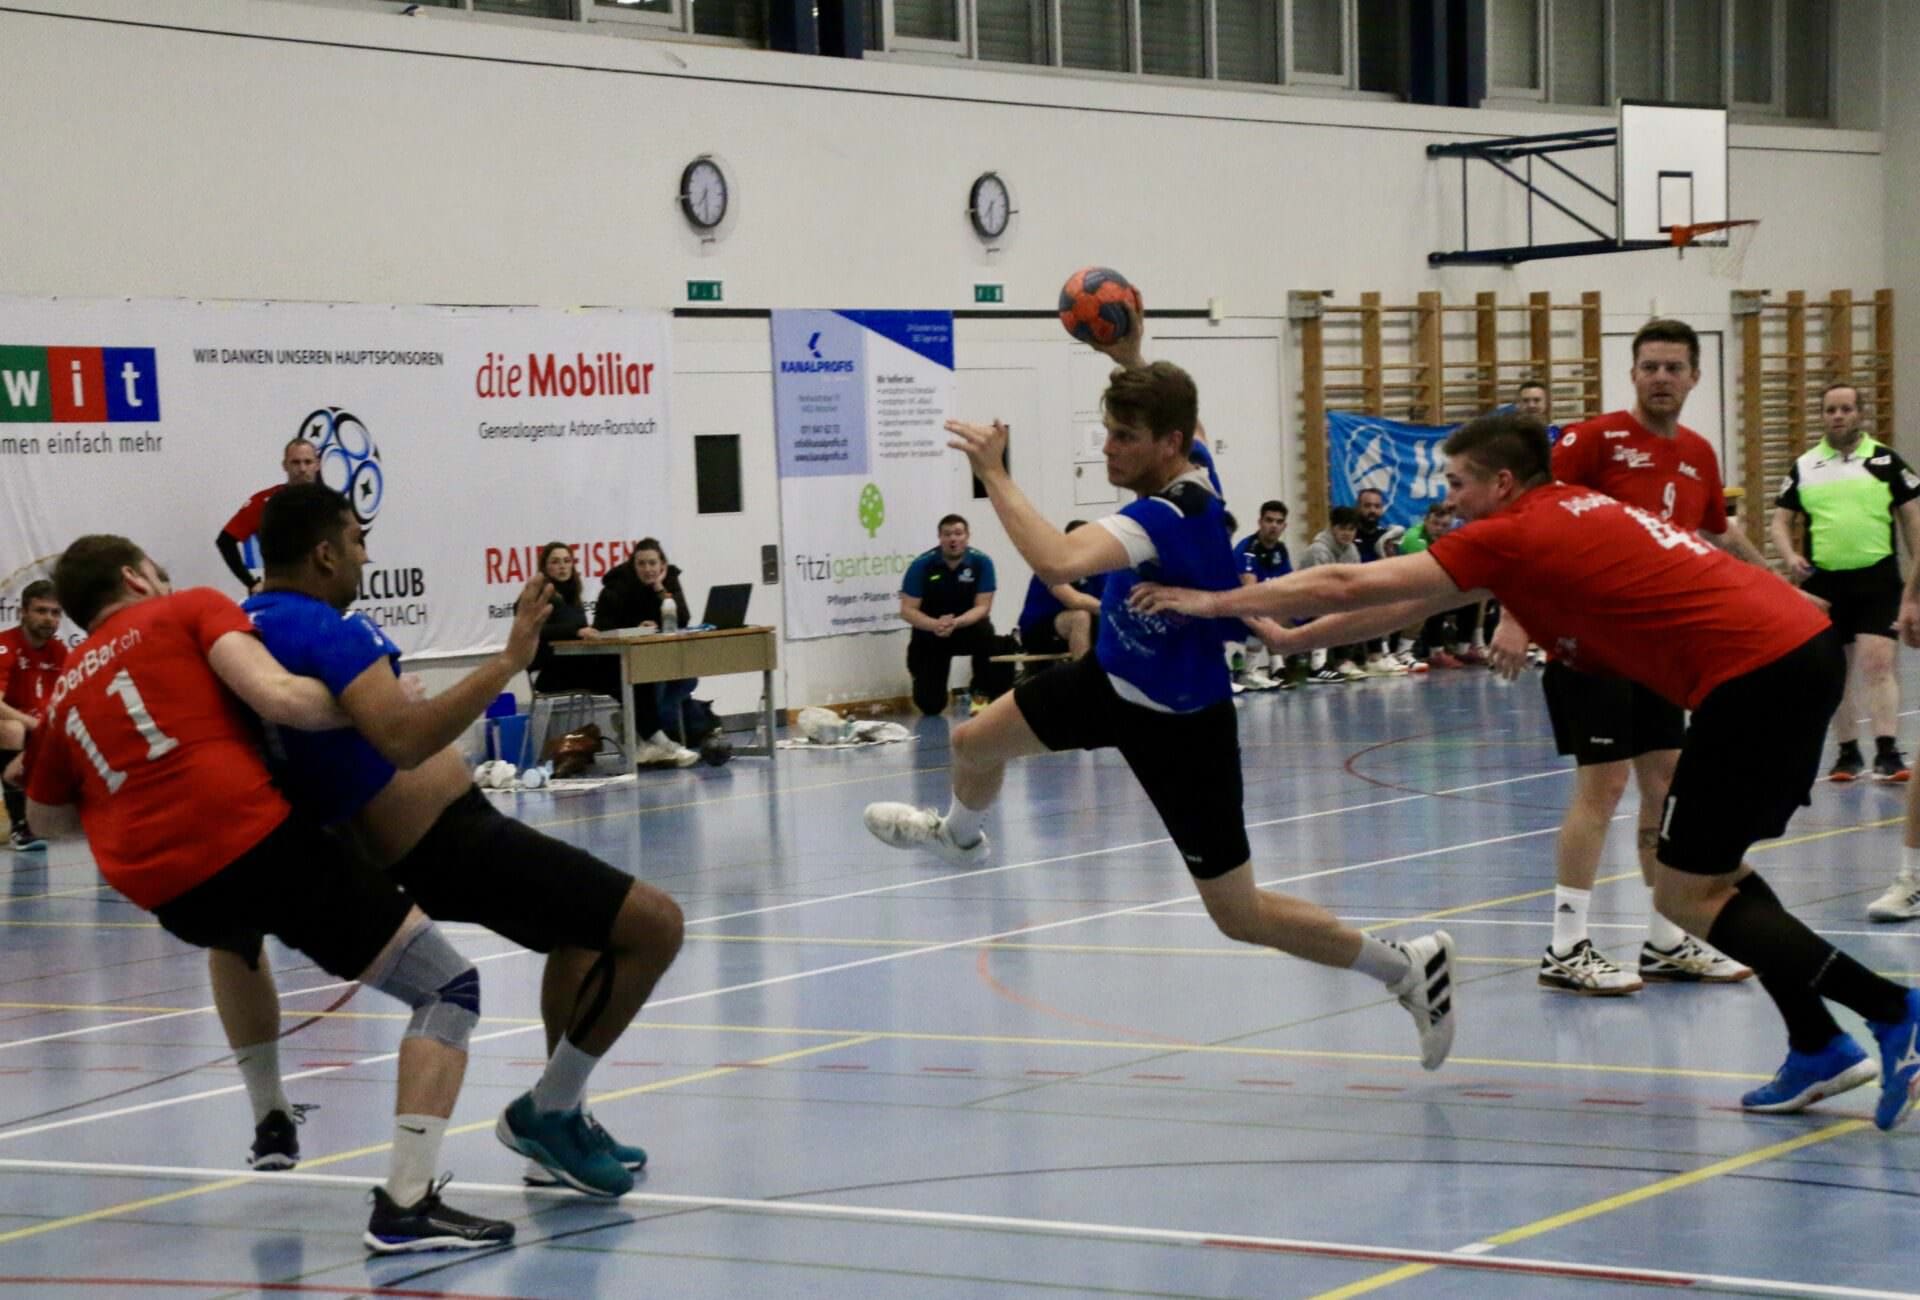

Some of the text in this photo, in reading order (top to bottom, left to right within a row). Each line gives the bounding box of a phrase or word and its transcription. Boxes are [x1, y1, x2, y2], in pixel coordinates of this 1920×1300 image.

[194, 349, 444, 366] WIR DANKEN UNSEREN HAUPTSPONSOREN
[476, 352, 654, 398] die Mobiliar
[480, 418, 656, 442] Generalagentur Arbon-Rorschach
[48, 431, 112, 454] einfach
[119, 431, 162, 453] mehr
[65, 667, 179, 795] 11
